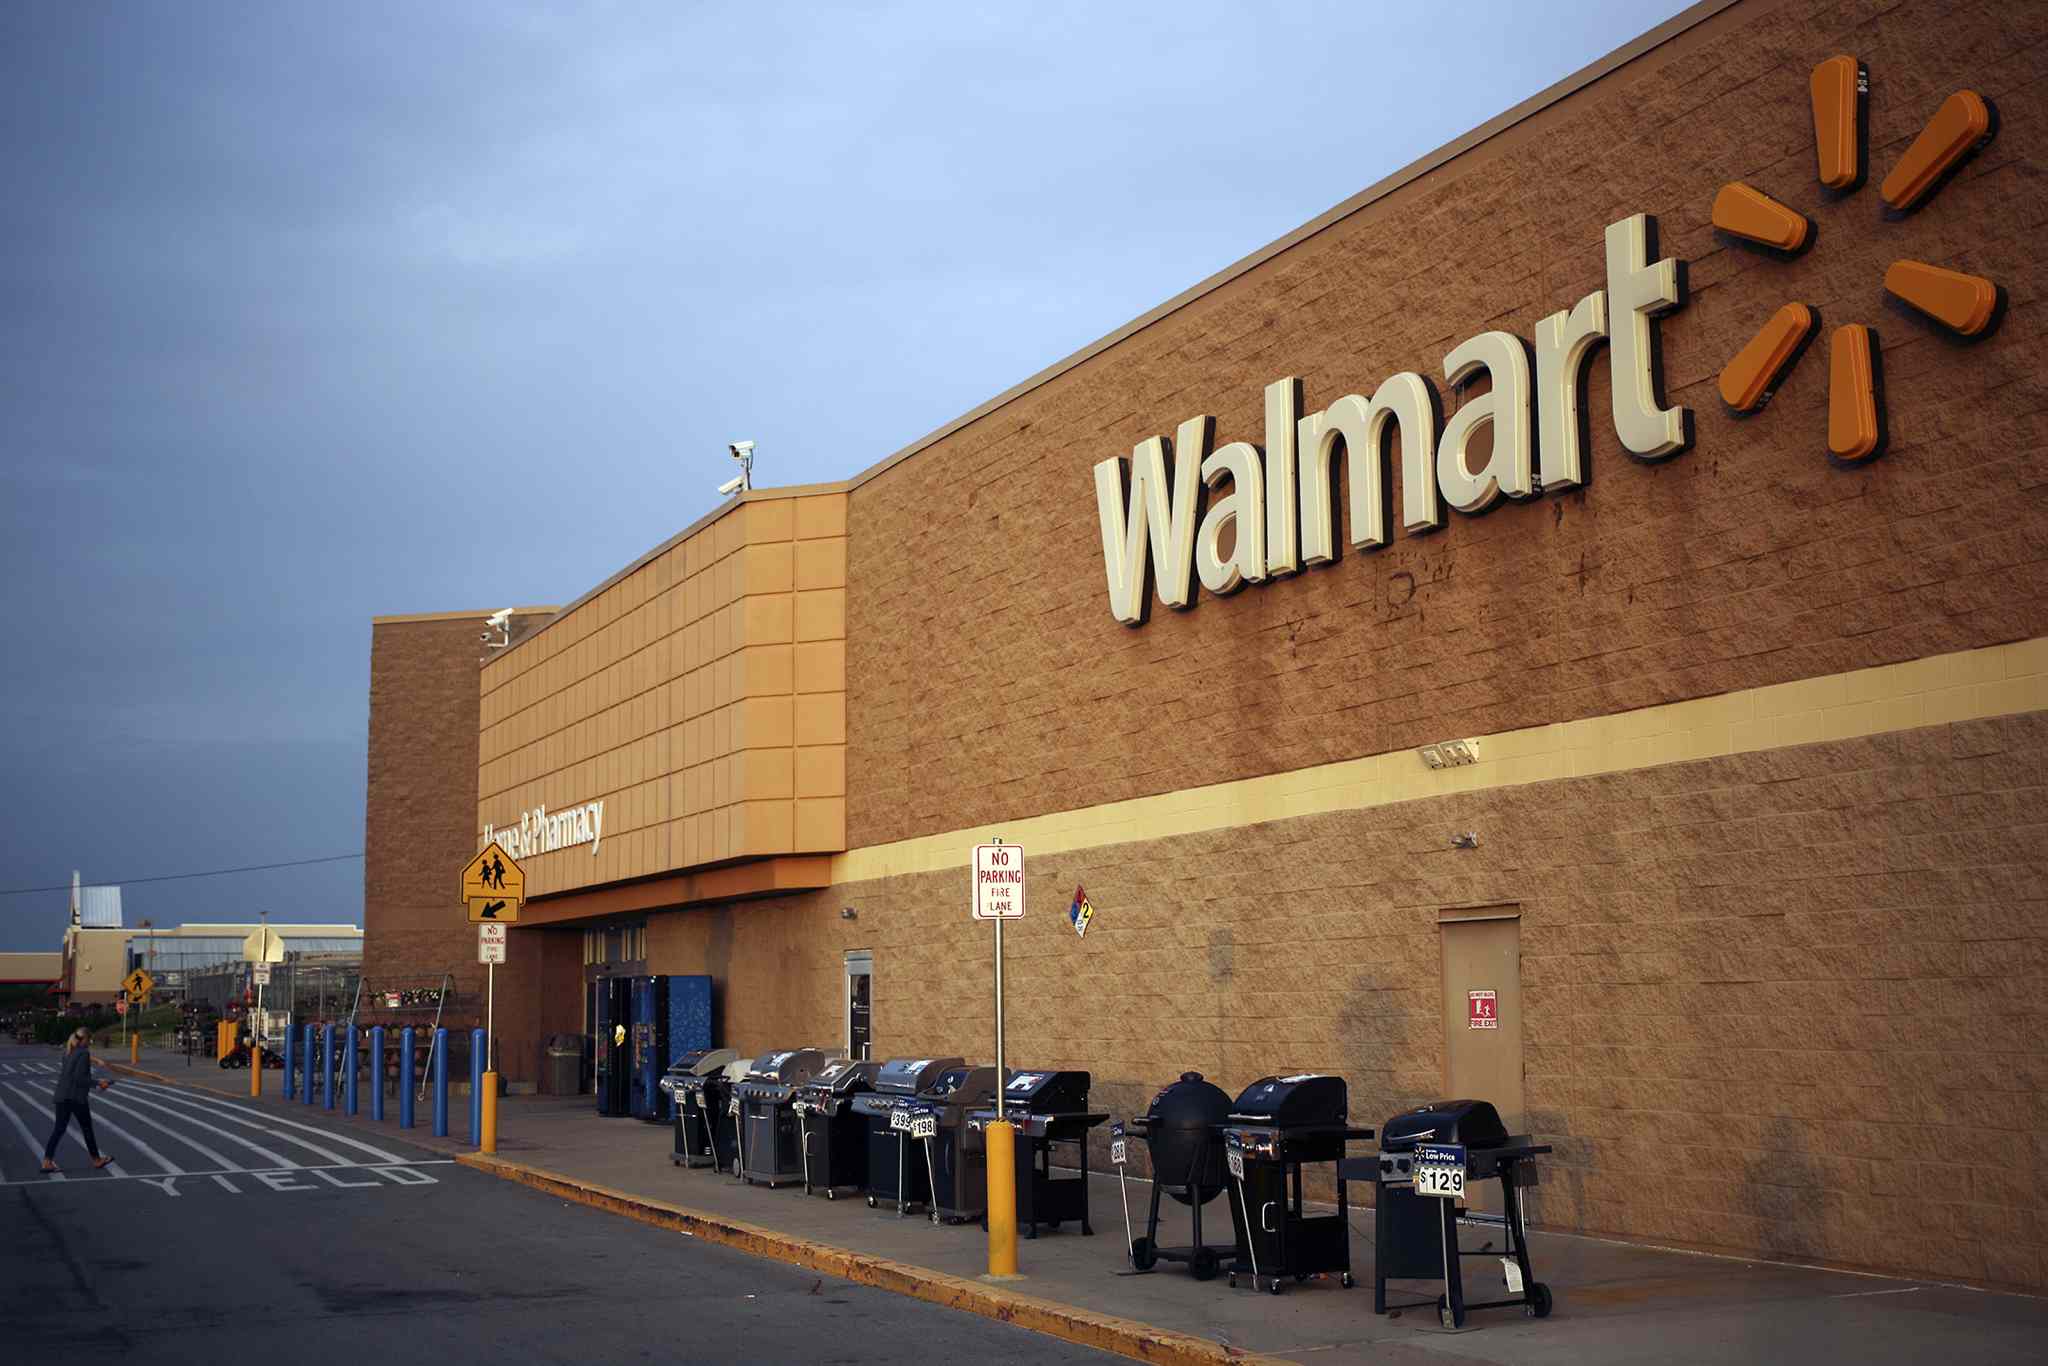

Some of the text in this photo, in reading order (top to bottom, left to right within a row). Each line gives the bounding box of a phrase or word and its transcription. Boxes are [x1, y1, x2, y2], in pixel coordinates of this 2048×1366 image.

[1094, 213, 1694, 627] Walmart
[520, 811, 532, 859] &
[533, 800, 604, 856] Pharmacy
[992, 852, 1009, 866] NO
[980, 870, 1021, 883] PARKING
[991, 887, 1010, 897] FIRE
[990, 901, 1012, 911] LANE
[1083, 902, 1089, 918] 2
[487, 927, 498, 935] NO
[1426, 1152, 1455, 1161] Low Price
[139, 1166, 439, 1197] YIELD
